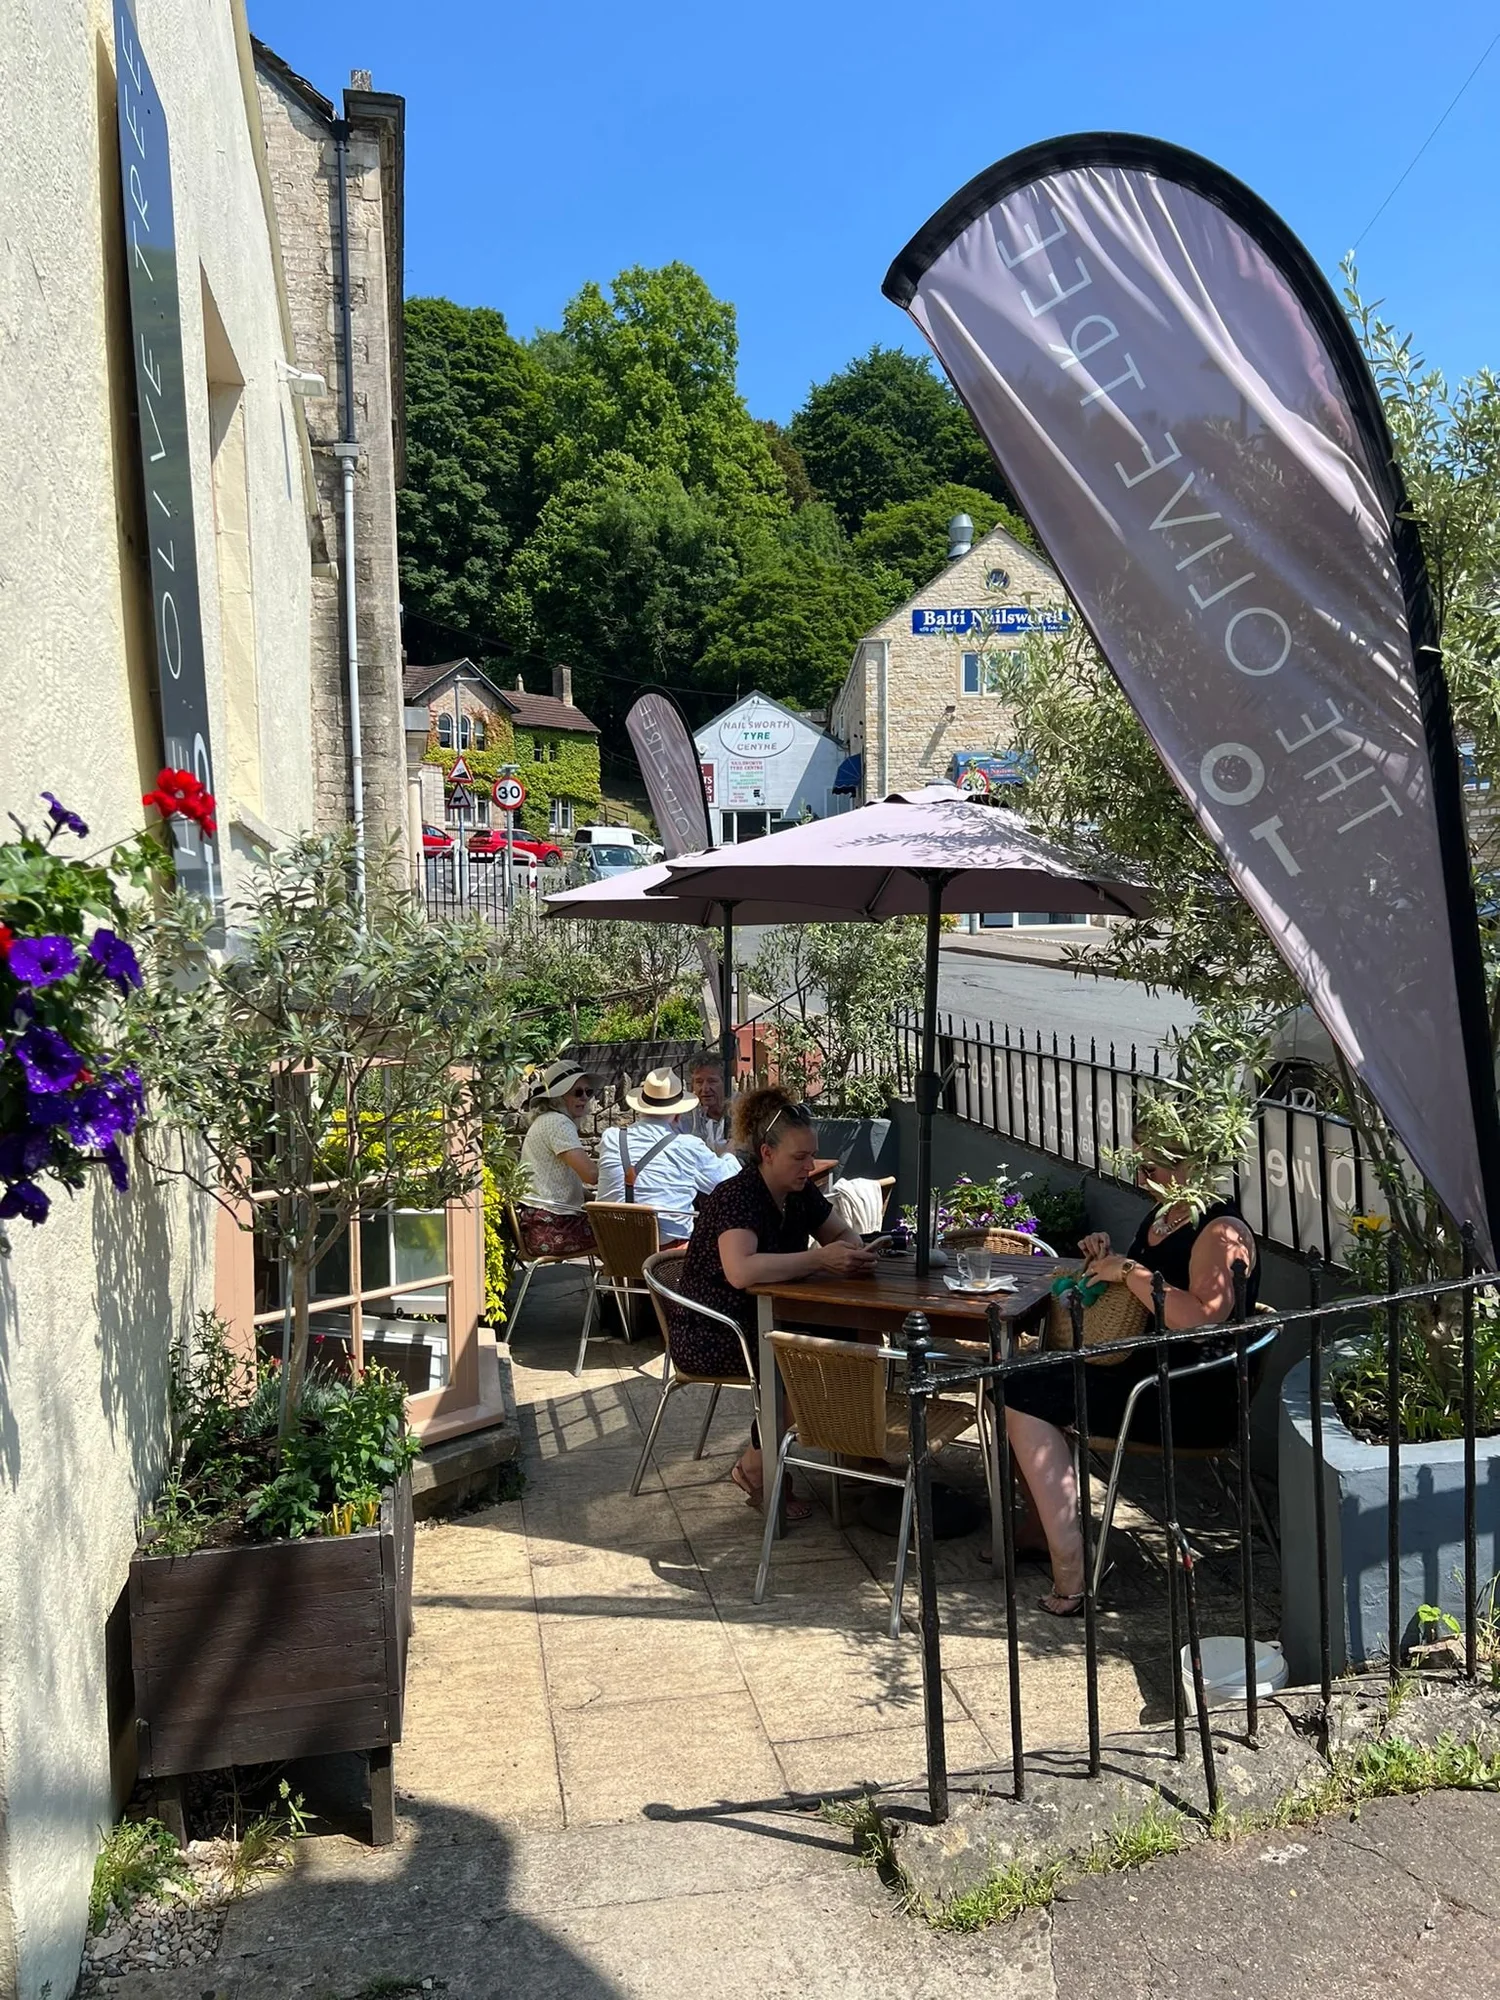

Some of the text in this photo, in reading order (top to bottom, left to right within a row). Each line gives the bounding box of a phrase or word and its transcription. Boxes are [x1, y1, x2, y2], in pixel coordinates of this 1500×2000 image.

[121, 15, 154, 281] TREE
[140, 333, 181, 679] OLIVE
[923, 610, 966, 626] Balti
[723, 720, 790, 730] NAILSWORTH
[743, 732, 770, 740] TYRE
[737, 743, 777, 751] CENTRE
[498, 786, 520, 799] 30
